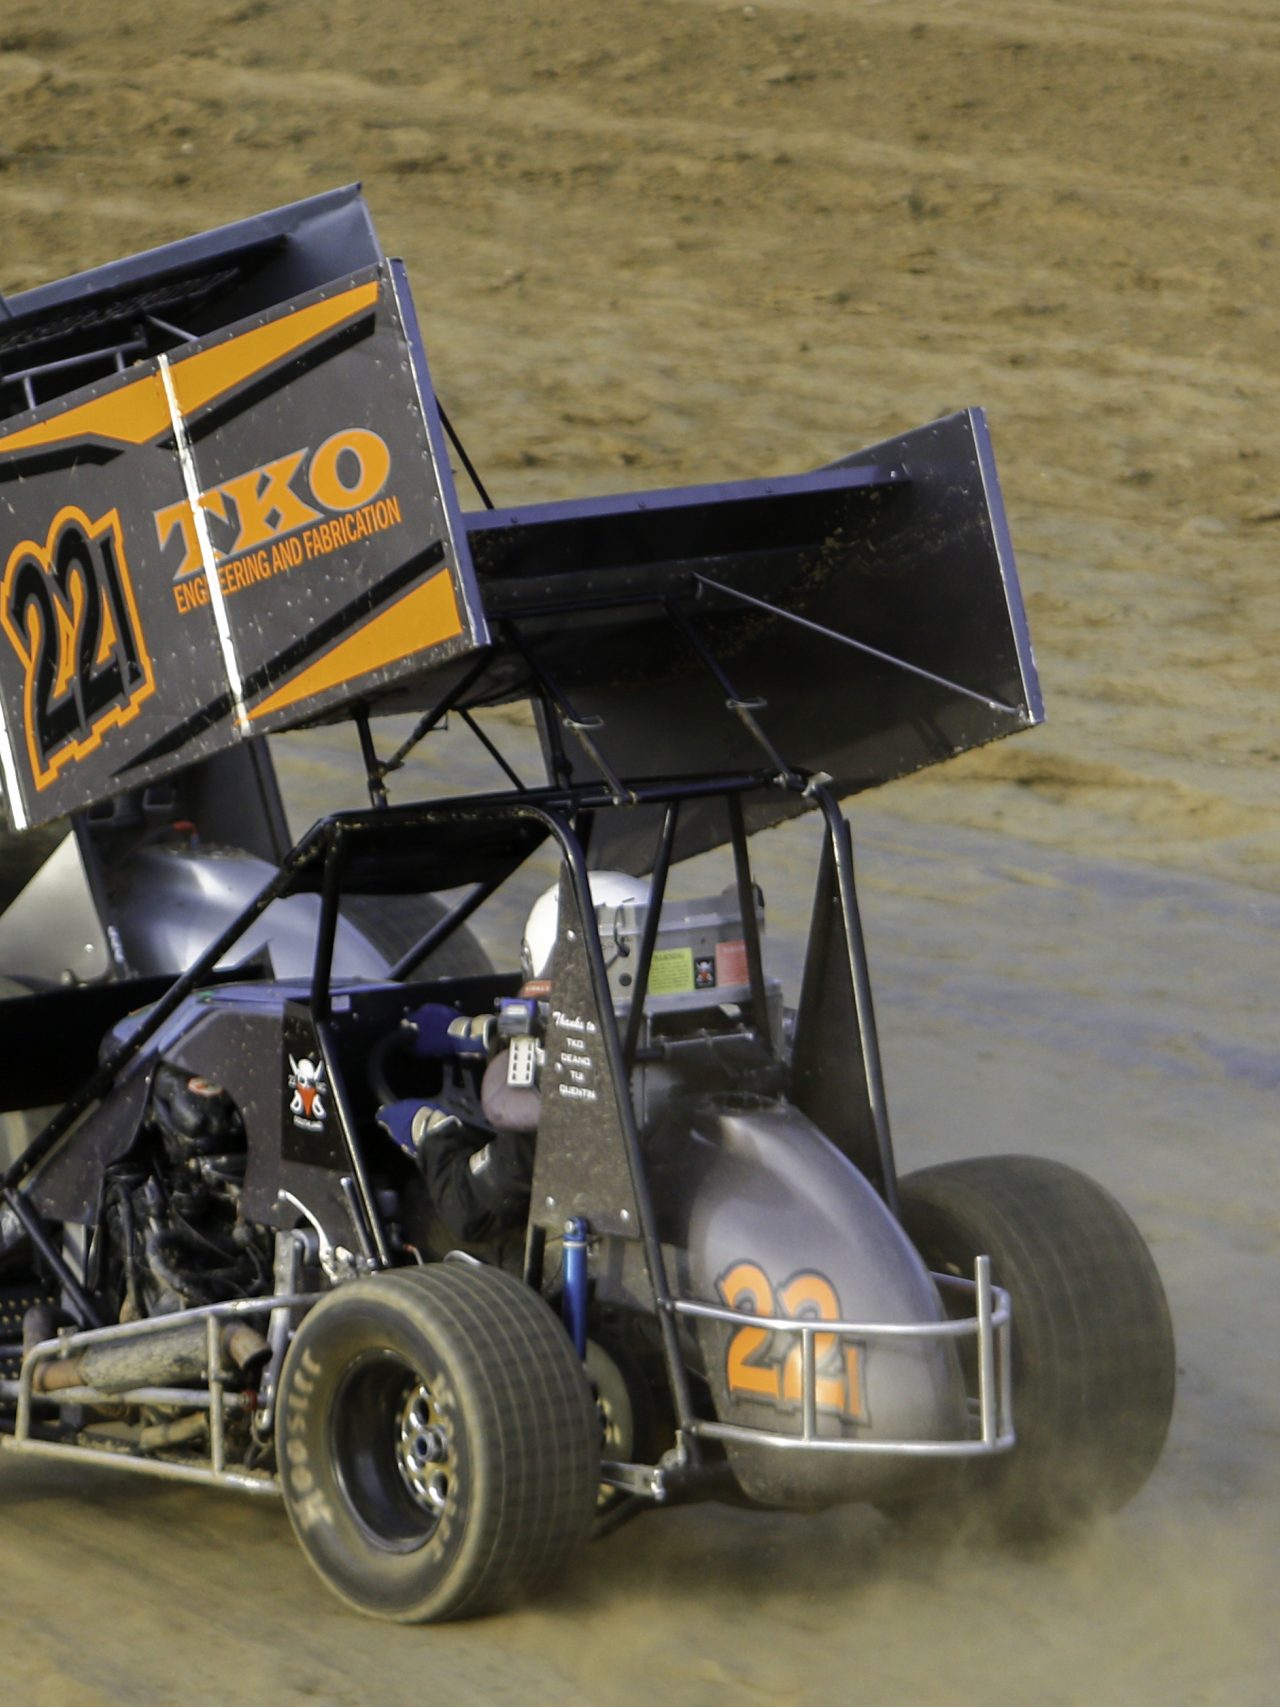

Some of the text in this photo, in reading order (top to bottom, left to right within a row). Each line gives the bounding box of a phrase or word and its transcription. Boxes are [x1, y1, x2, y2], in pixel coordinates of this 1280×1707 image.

[154, 427, 391, 581] TKO
[271, 537, 303, 573] AND
[302, 496, 402, 560] FABRICATION
[552, 1011, 585, 1031] Thanks
[566, 1037, 585, 1050] TKO
